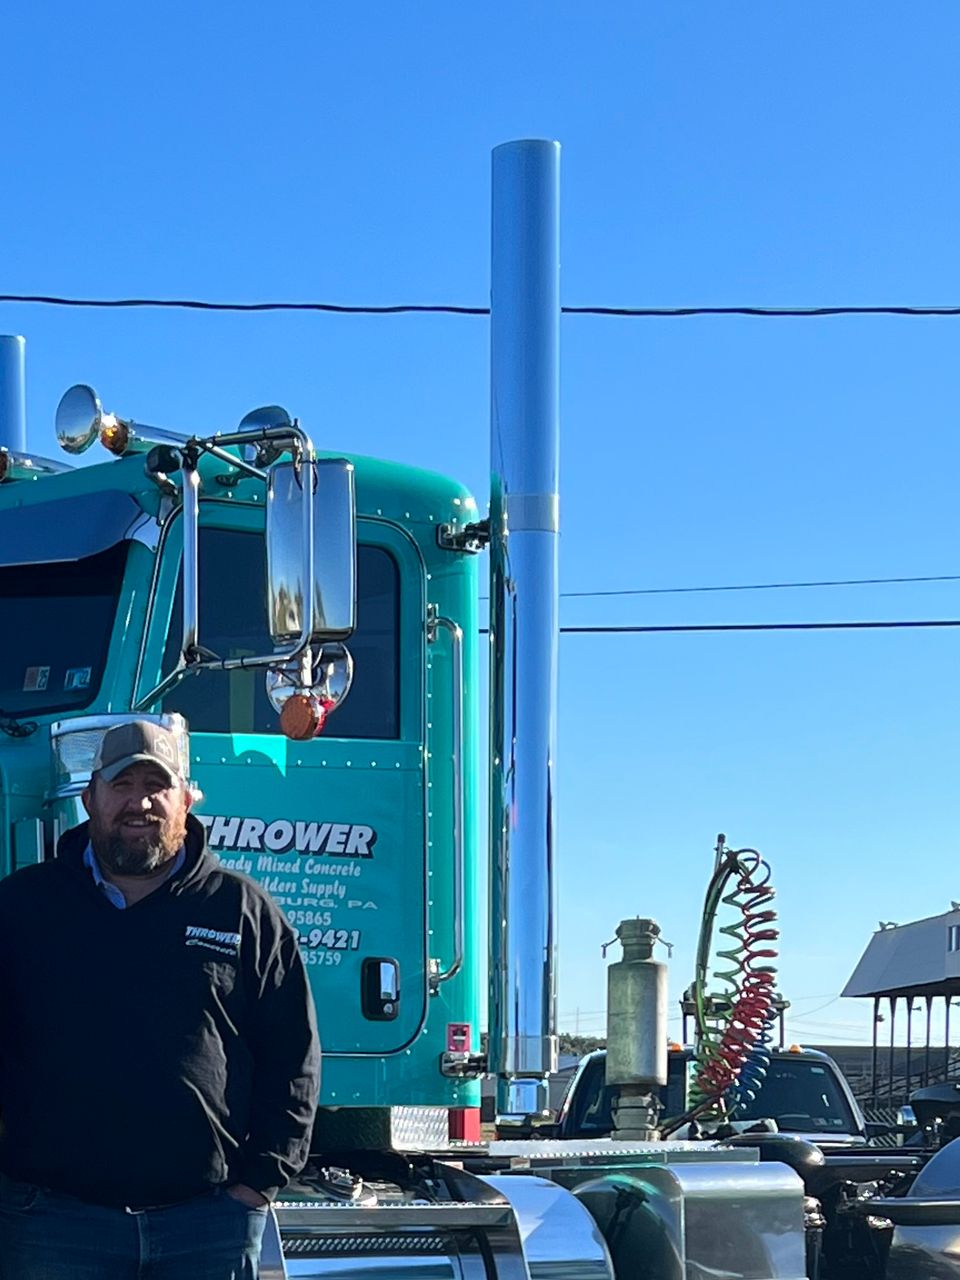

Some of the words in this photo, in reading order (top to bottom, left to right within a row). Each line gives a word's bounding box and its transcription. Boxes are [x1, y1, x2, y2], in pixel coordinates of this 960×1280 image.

[214, 854, 252, 874] eady
[257, 855, 301, 874] Mixed
[304, 858, 361, 877] Concrete
[300, 878, 346, 899] Supply
[347, 900, 378, 910] PA
[287, 910, 332, 926] 95865
